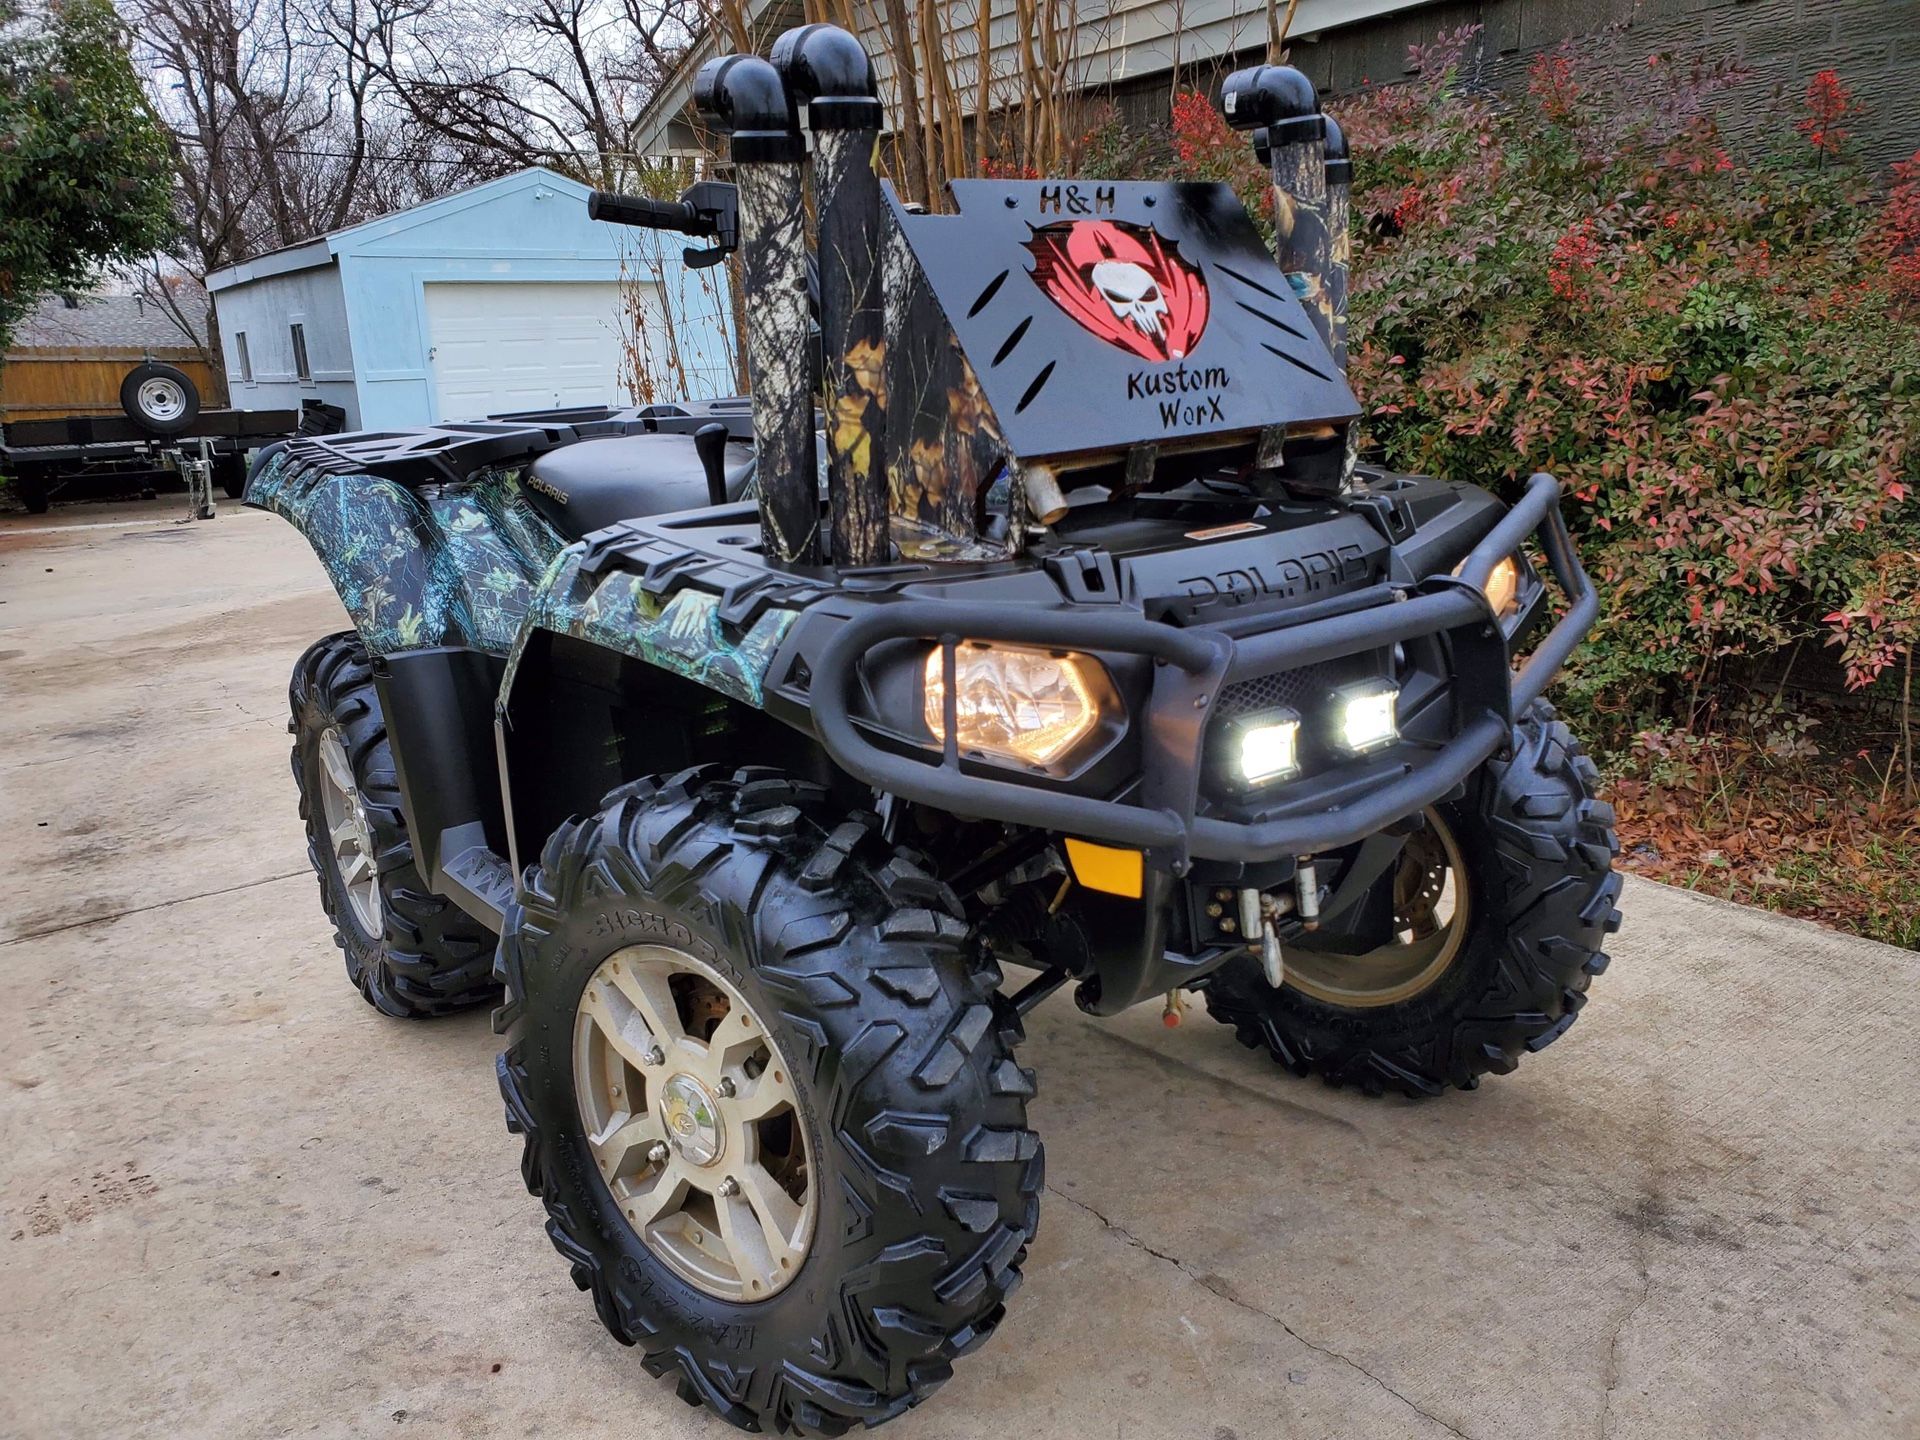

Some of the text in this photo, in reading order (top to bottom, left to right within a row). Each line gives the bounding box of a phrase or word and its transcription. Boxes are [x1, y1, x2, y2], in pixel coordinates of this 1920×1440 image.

[1040, 186, 1115, 215] H&H
[1128, 363, 1230, 399] Kustom
[1159, 396, 1225, 429] WorX
[528, 476, 569, 504] POLARIS
[1178, 544, 1368, 614] POLARIS
